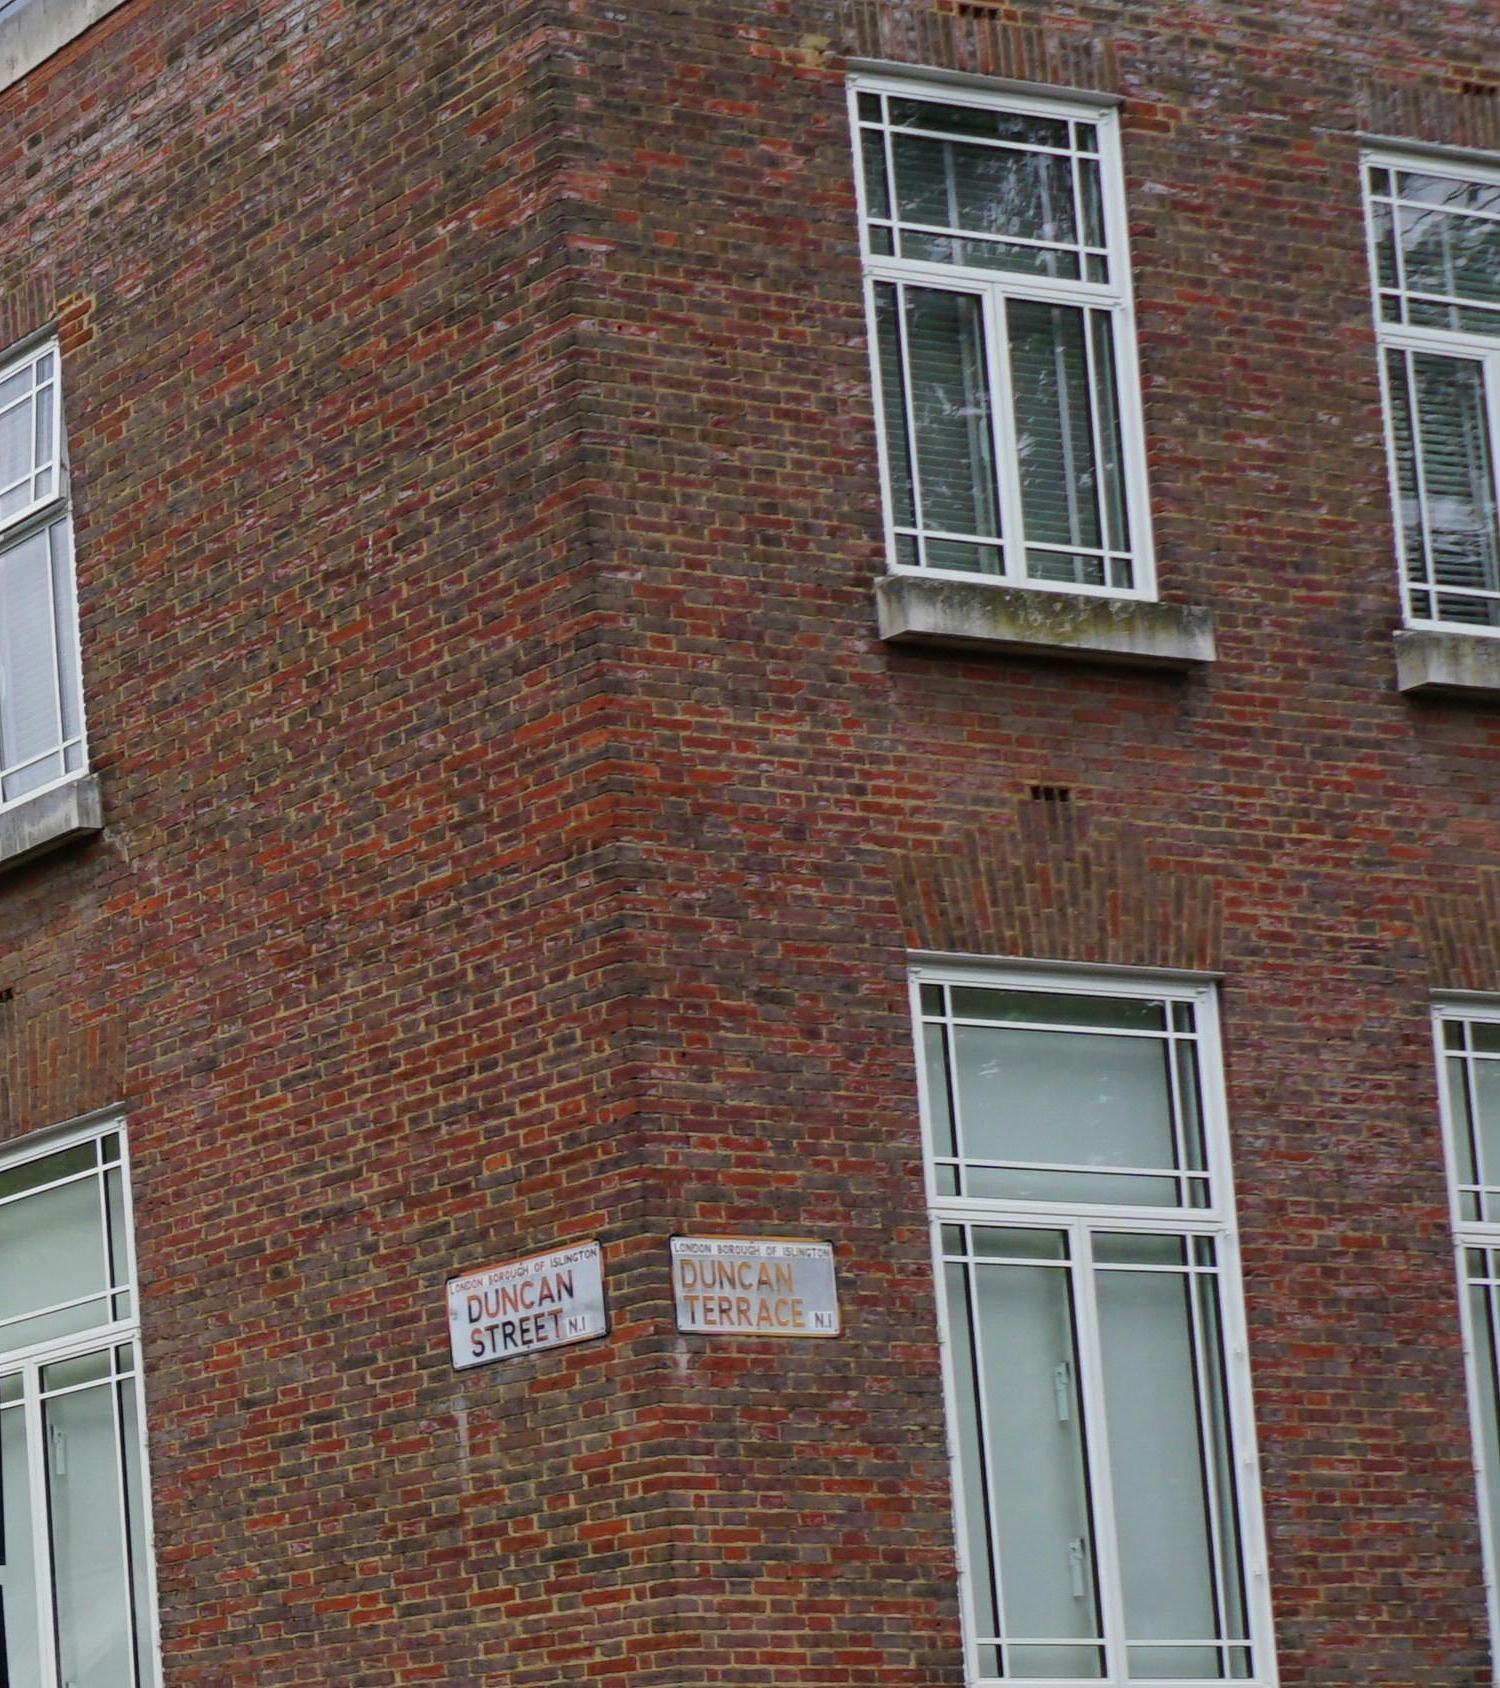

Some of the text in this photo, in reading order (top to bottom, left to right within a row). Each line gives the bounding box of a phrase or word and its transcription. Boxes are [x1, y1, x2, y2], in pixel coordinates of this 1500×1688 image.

[450, 1247, 597, 1294] LONDON BOROUGH OF ISLINGTON
[674, 1243, 831, 1258] LONDON BOROUGH OF ISLINGTON
[679, 1259, 794, 1292] DUNCAN
[467, 1270, 574, 1324] DUNCAN
[683, 1295, 806, 1328] TERRACE
[470, 1308, 563, 1357] STREET
